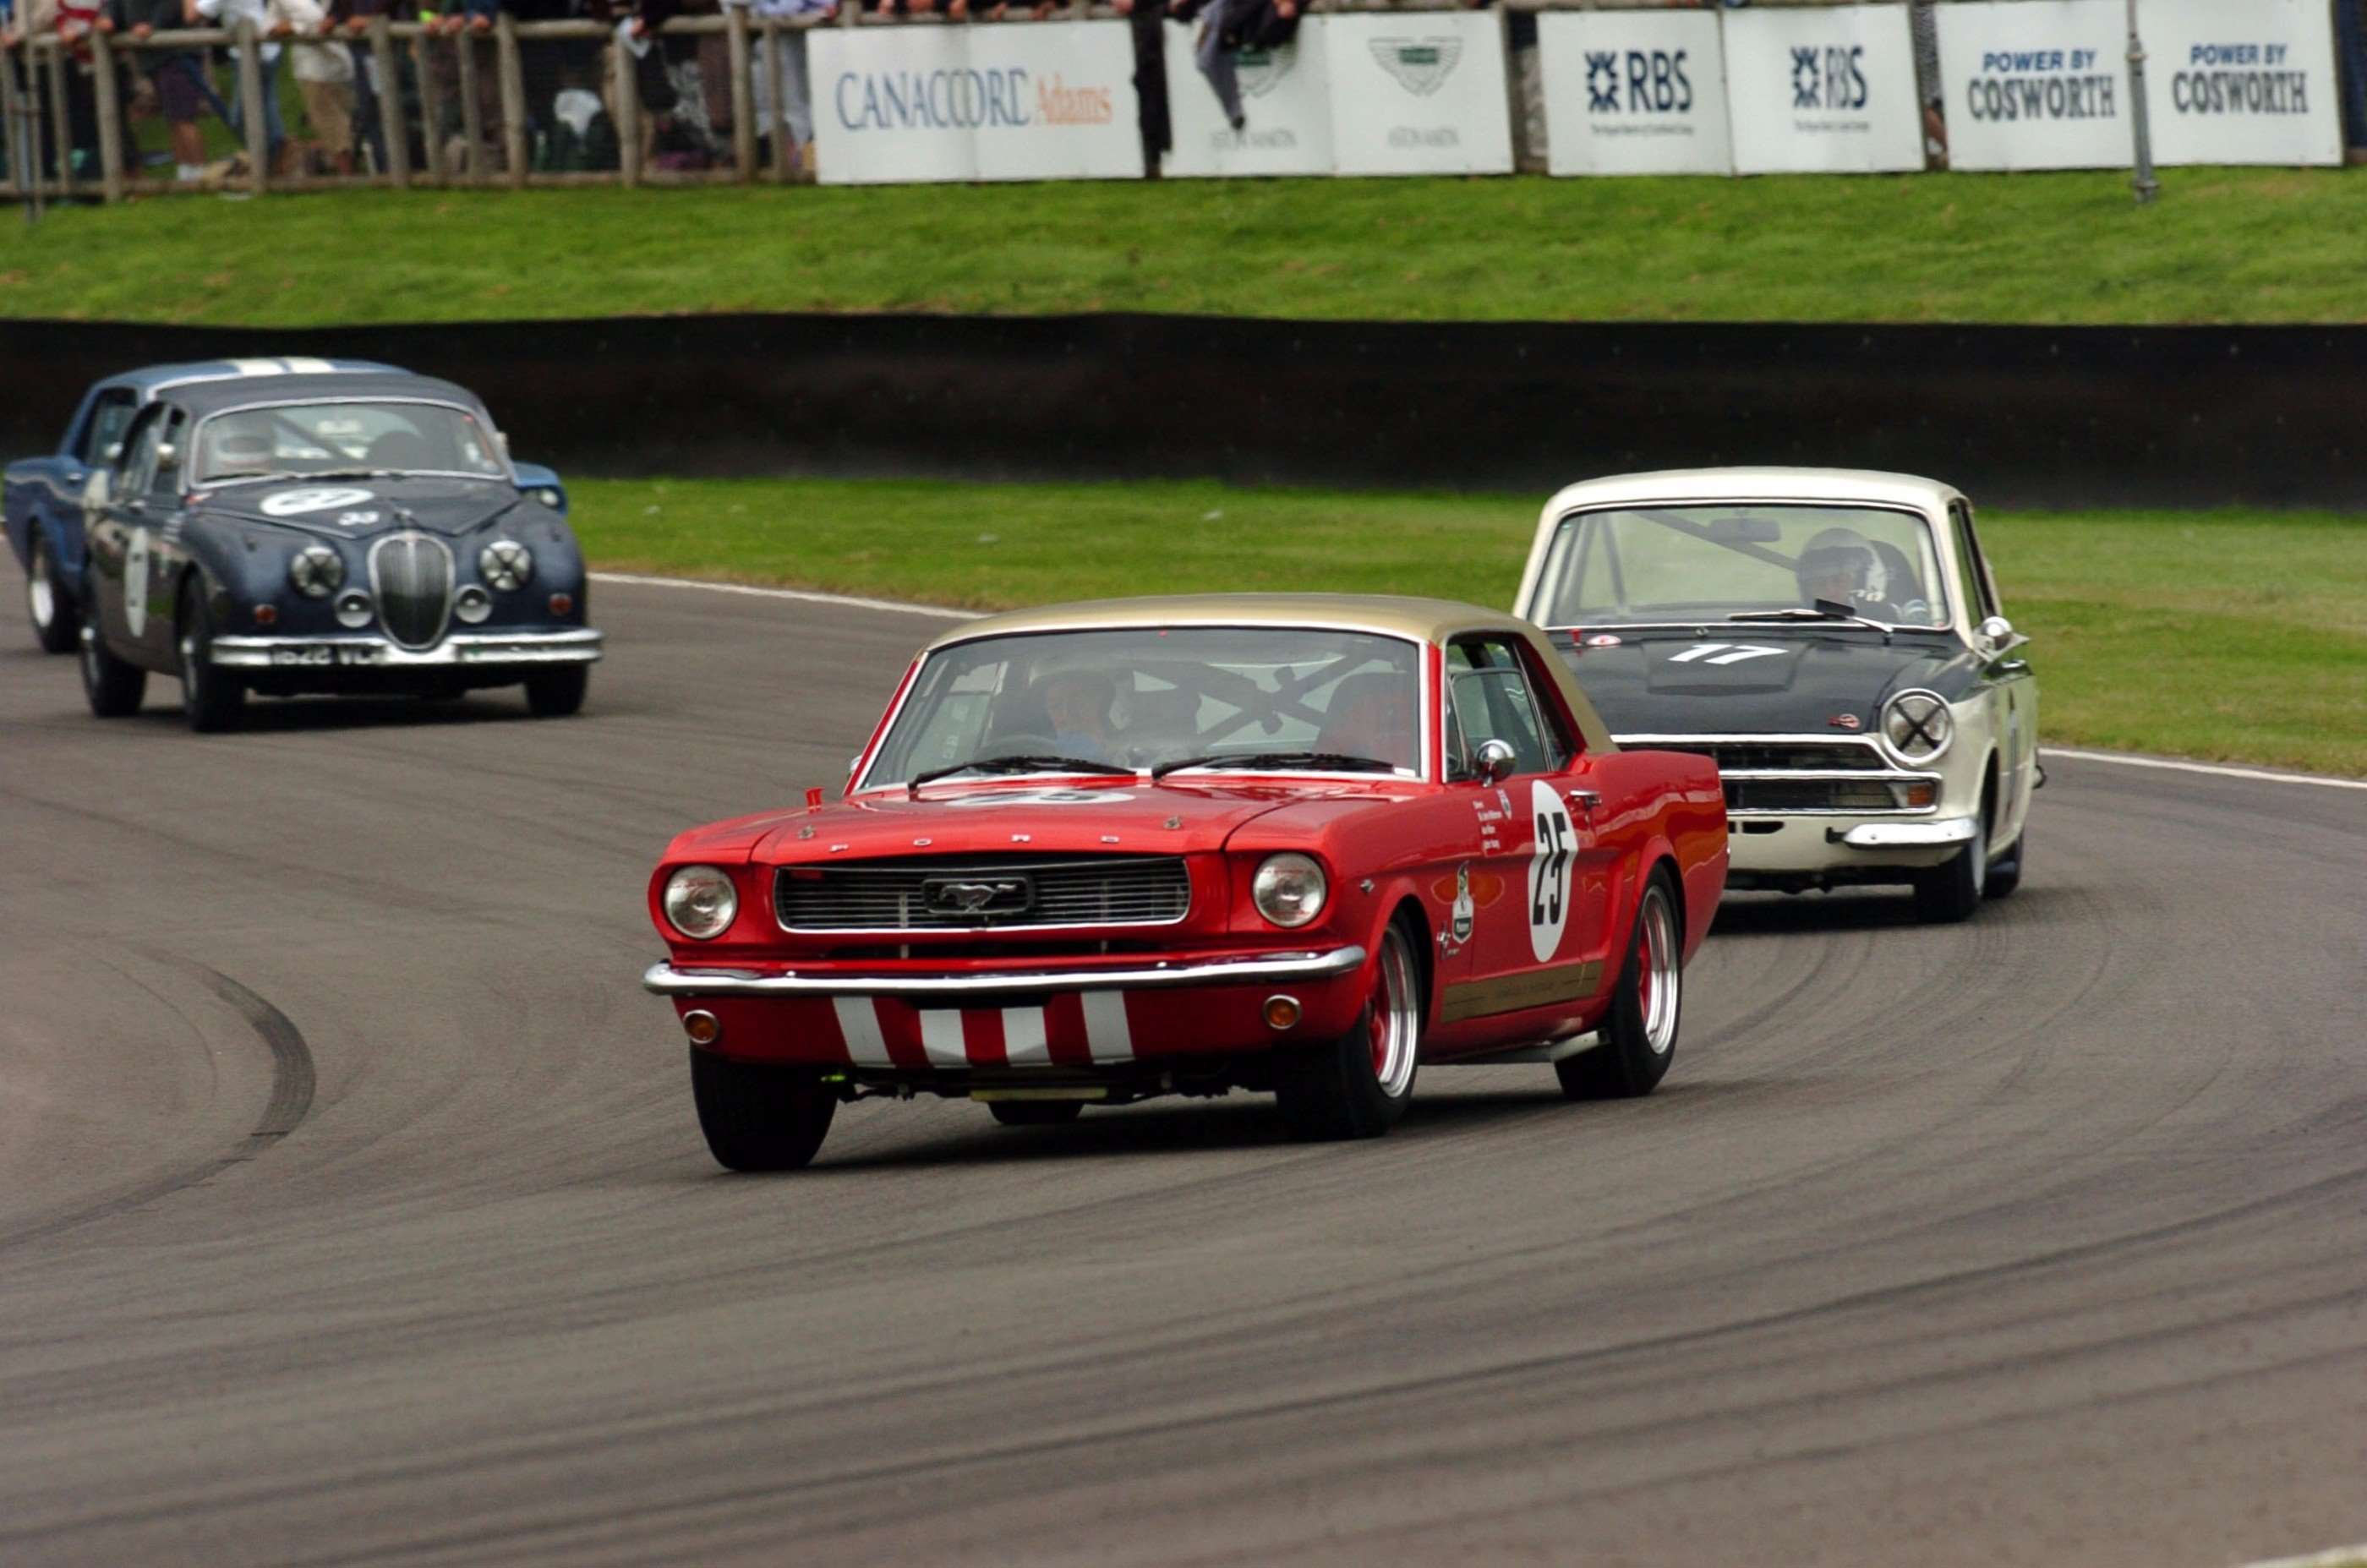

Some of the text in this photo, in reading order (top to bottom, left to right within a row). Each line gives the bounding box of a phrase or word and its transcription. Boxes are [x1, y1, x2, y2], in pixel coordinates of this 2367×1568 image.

[1982, 49, 2097, 73] POWER BY
[2189, 43, 2289, 67] POWER BY
[1035, 72, 1113, 125] Adams
[1626, 49, 1693, 113] RBS
[1967, 75, 2117, 122] COSWORTH
[2173, 70, 2310, 115] COSWORTH
[1667, 643, 1790, 664] 17
[1532, 811, 1569, 926] 25
